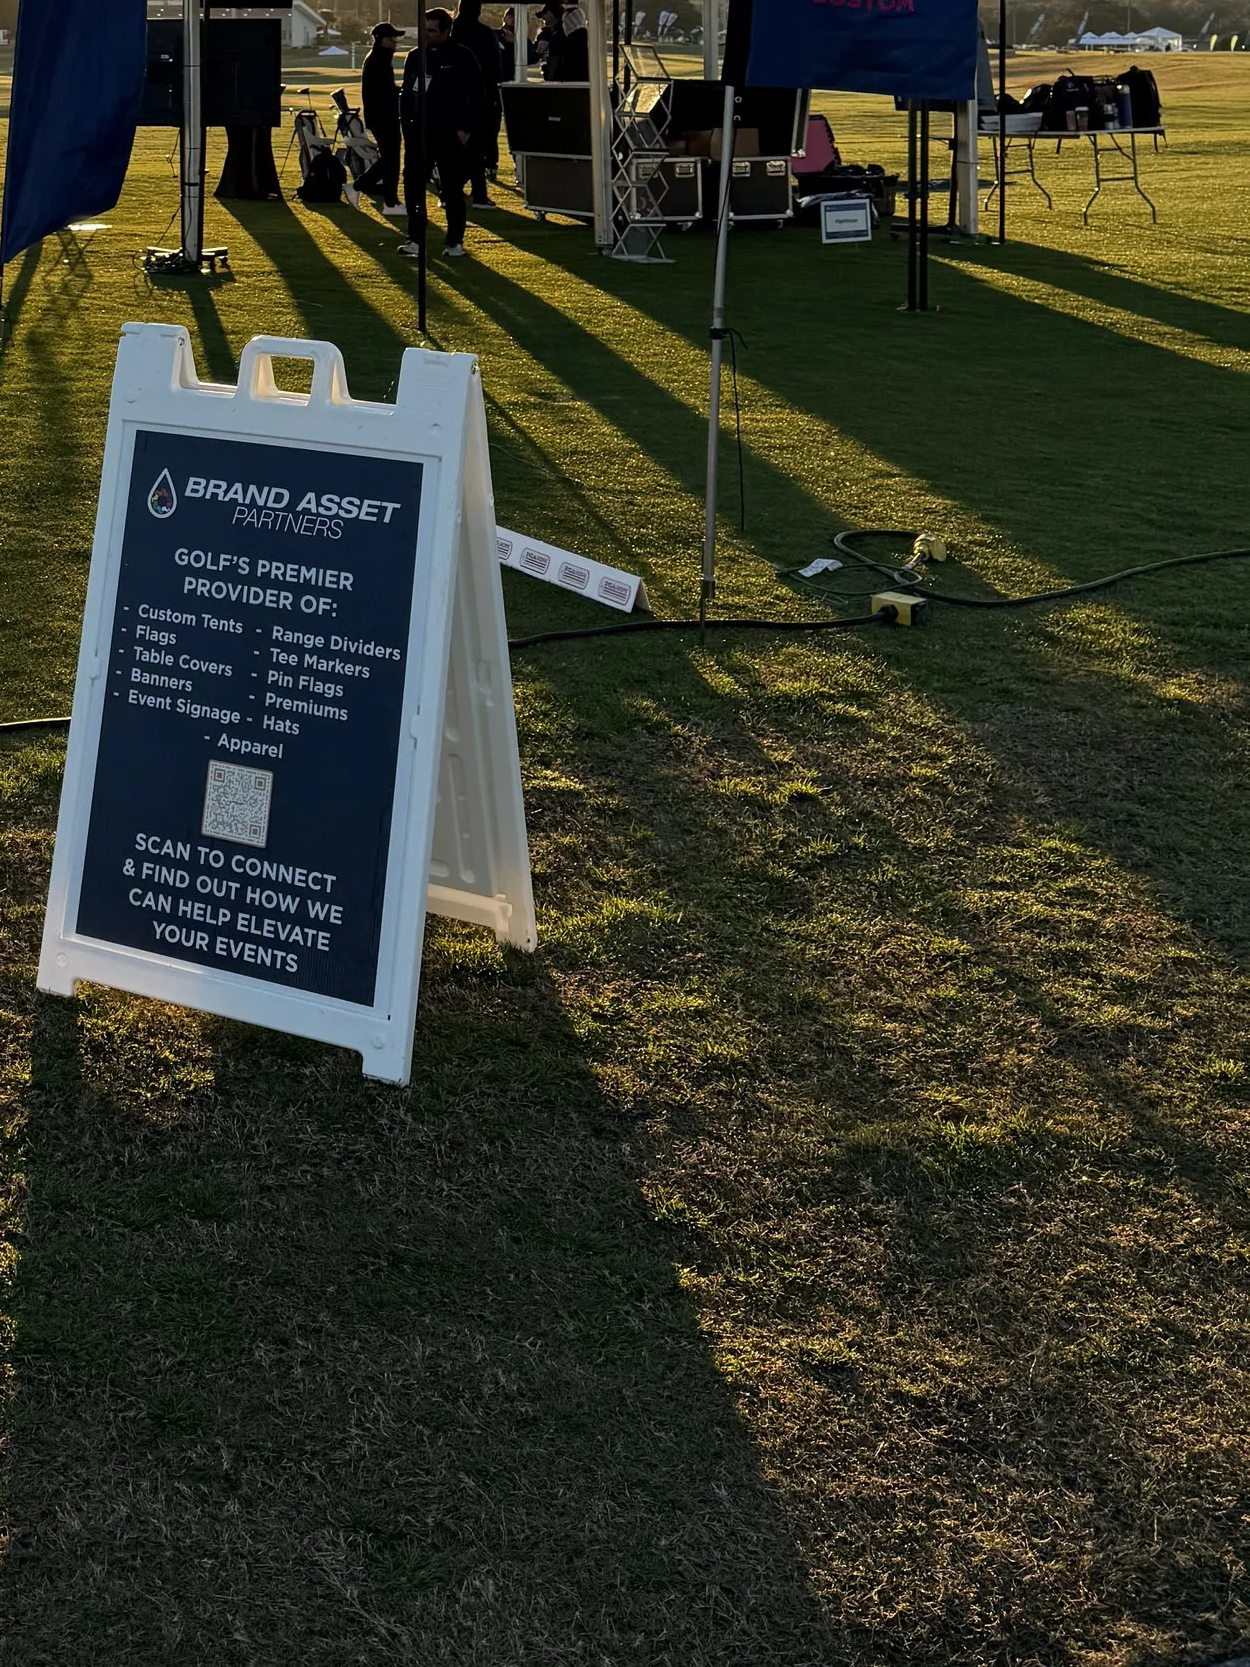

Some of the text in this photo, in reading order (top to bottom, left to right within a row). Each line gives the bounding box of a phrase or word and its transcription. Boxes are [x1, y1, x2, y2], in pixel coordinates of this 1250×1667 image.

[184, 476, 401, 523] BRAND ASSET
[232, 507, 344, 539] PARTNERS
[174, 548, 354, 591] GOLF'S PREMIER
[183, 577, 338, 617] PROVIDER OF:
[138, 604, 243, 634] Custom Tents
[135, 625, 177, 646] Flags
[272, 626, 401, 661] Range Dividers
[133, 646, 233, 677] Table Covers
[270, 648, 370, 679] Tee Markers
[130, 668, 193, 692] Banners
[267, 670, 344, 698] Pin Flags
[128, 690, 241, 724] Event Signage
[265, 692, 348, 721] Premiums
[262, 715, 300, 735] Hats
[217, 734, 284, 759] Apparel
[134, 833, 336, 893] SCAN TO CONNECT
[122, 858, 343, 925] & FIND OUT HOW WE
[128, 888, 331, 952] CAN HELP ELEVATE
[153, 920, 298, 973] YOUR EVENTS
